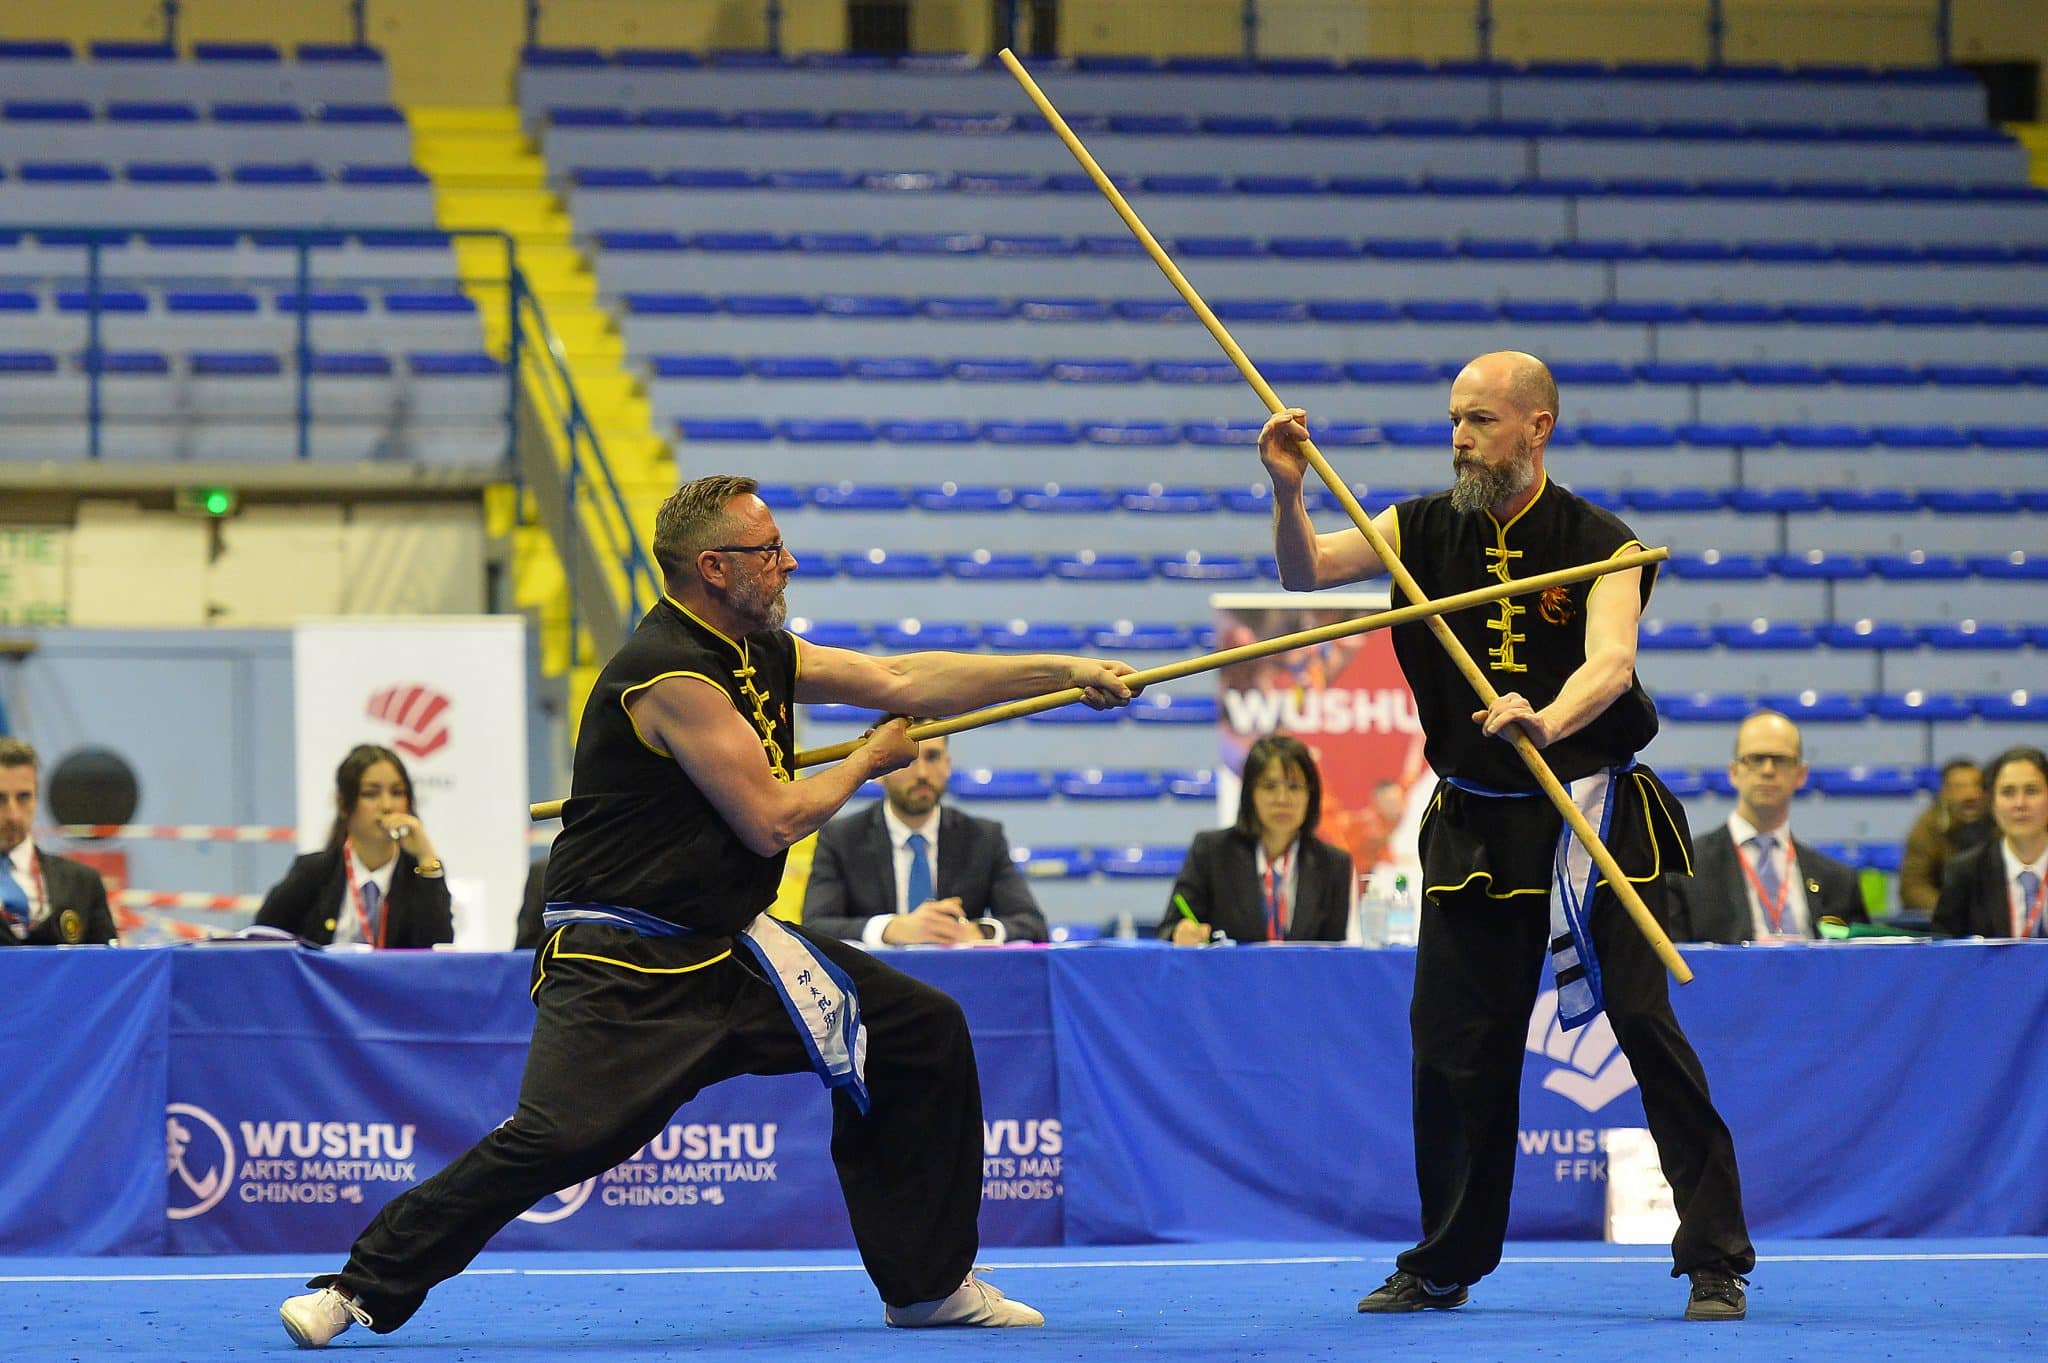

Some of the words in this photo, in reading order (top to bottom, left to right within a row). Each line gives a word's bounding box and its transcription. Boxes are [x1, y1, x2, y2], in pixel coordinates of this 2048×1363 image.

[1224, 688, 1420, 735] WUSHU
[240, 1121, 416, 1160] WUSHU
[629, 1123, 777, 1161] USHU
[240, 1160, 297, 1181] ARTS
[301, 1160, 417, 1182] MARTIAUX
[602, 1163, 658, 1183] ARTS
[662, 1162, 777, 1182] MARTIAUX
[240, 1182, 338, 1204] CHINOIS
[602, 1185, 699, 1206] CHINOIS
